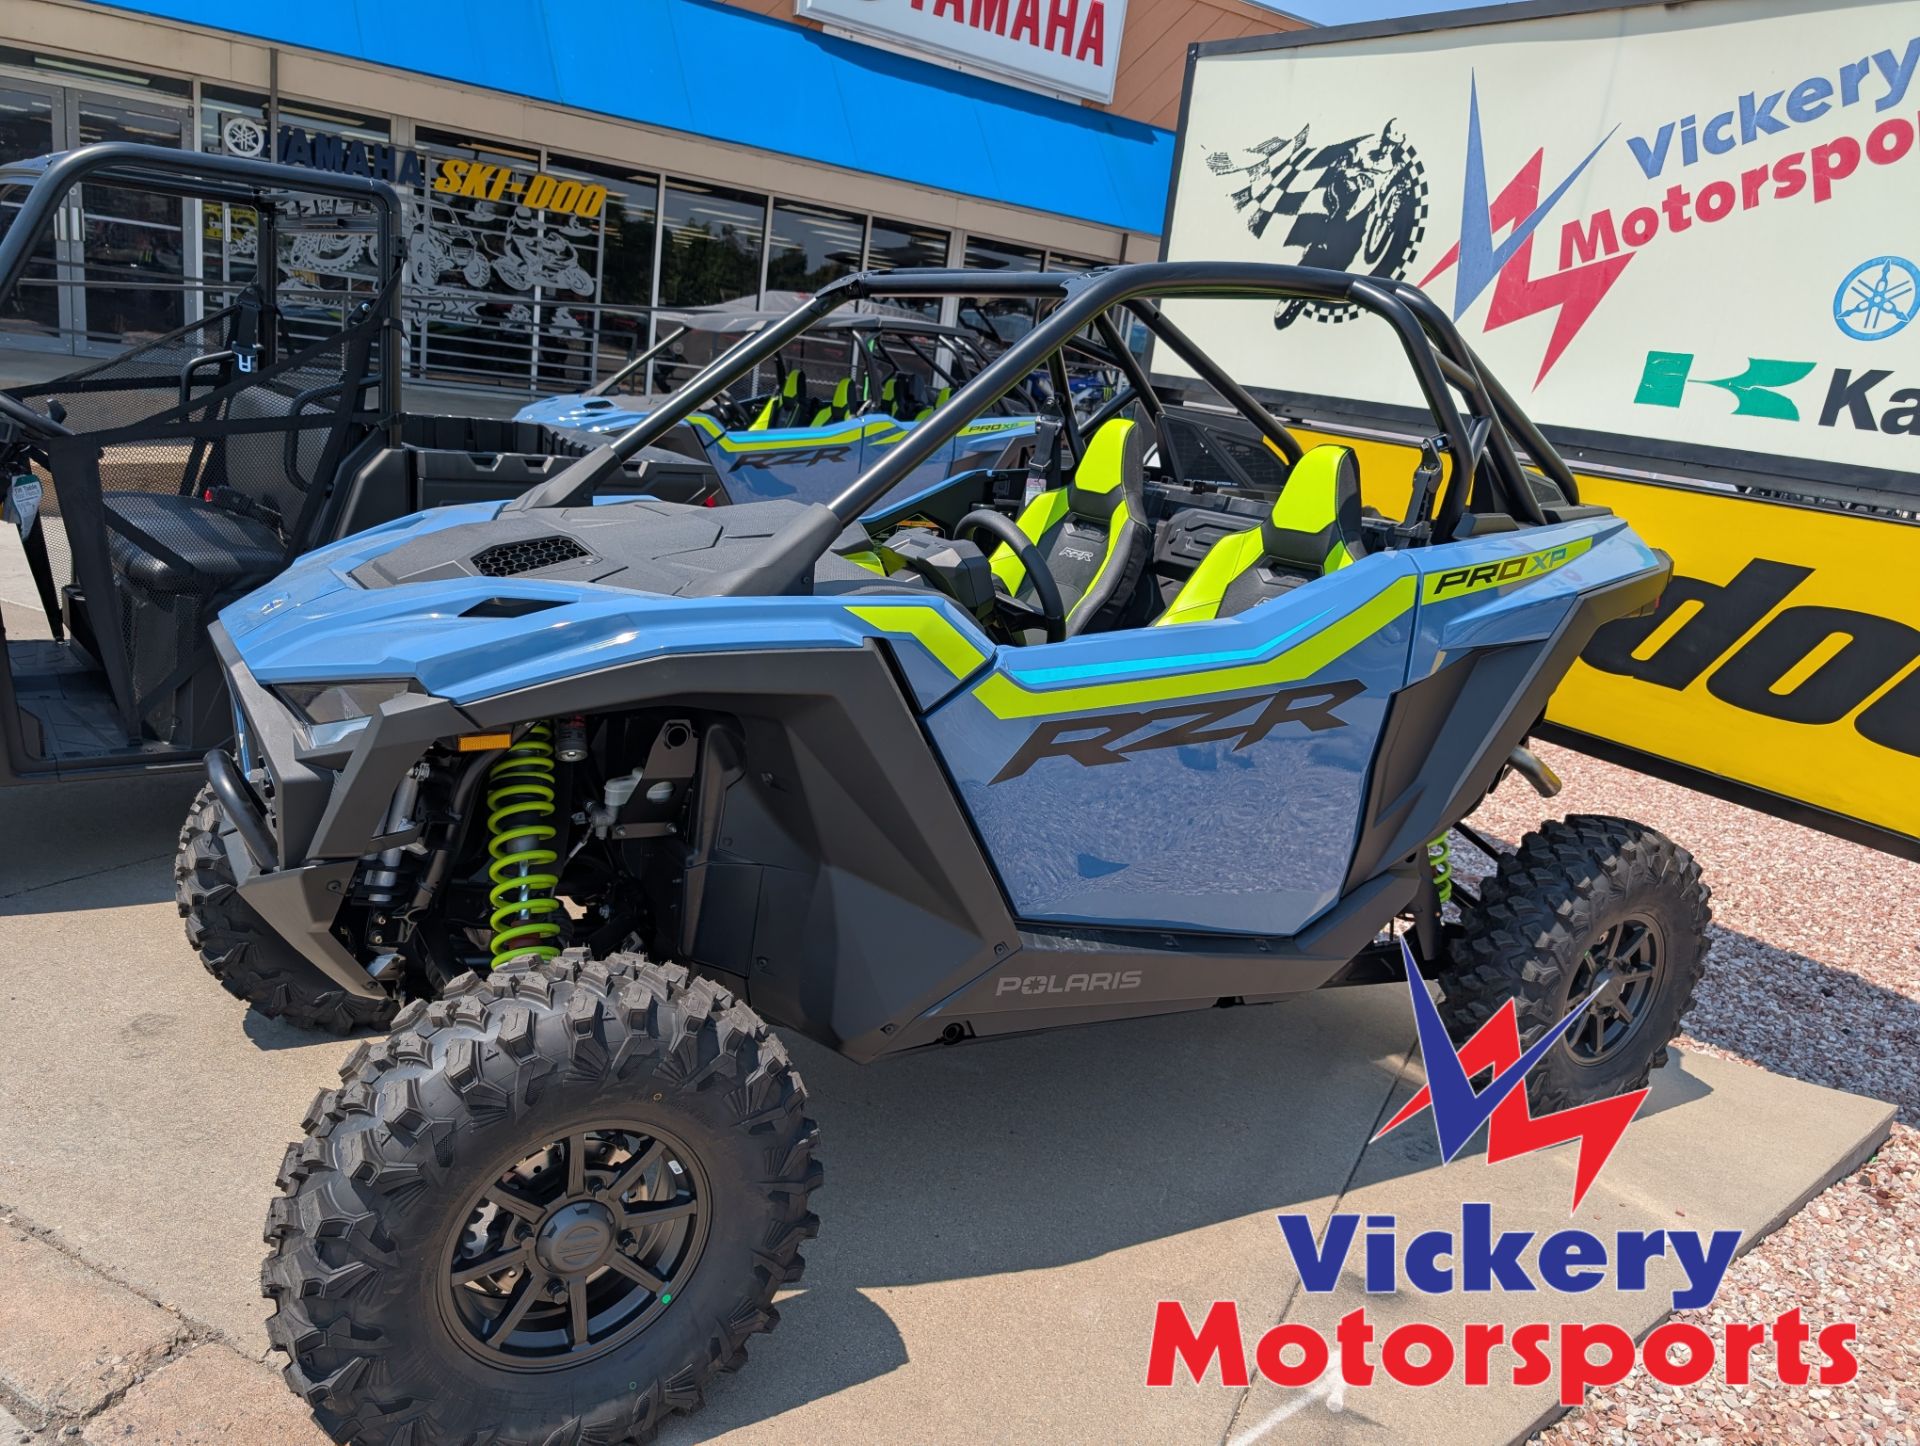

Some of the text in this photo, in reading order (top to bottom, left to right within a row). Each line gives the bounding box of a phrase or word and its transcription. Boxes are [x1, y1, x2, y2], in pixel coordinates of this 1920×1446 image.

[910, 0, 1104, 67] AHA
[1626, 36, 1920, 180] Vickery
[264, 125, 425, 187] YAMAHA
[434, 159, 608, 218] SKI-DOO
[1558, 110, 1920, 271] Motorspo
[728, 446, 852, 473] RZR
[1579, 557, 1920, 758] do
[986, 678, 1368, 786] RZR
[995, 970, 1143, 997] POLARIS
